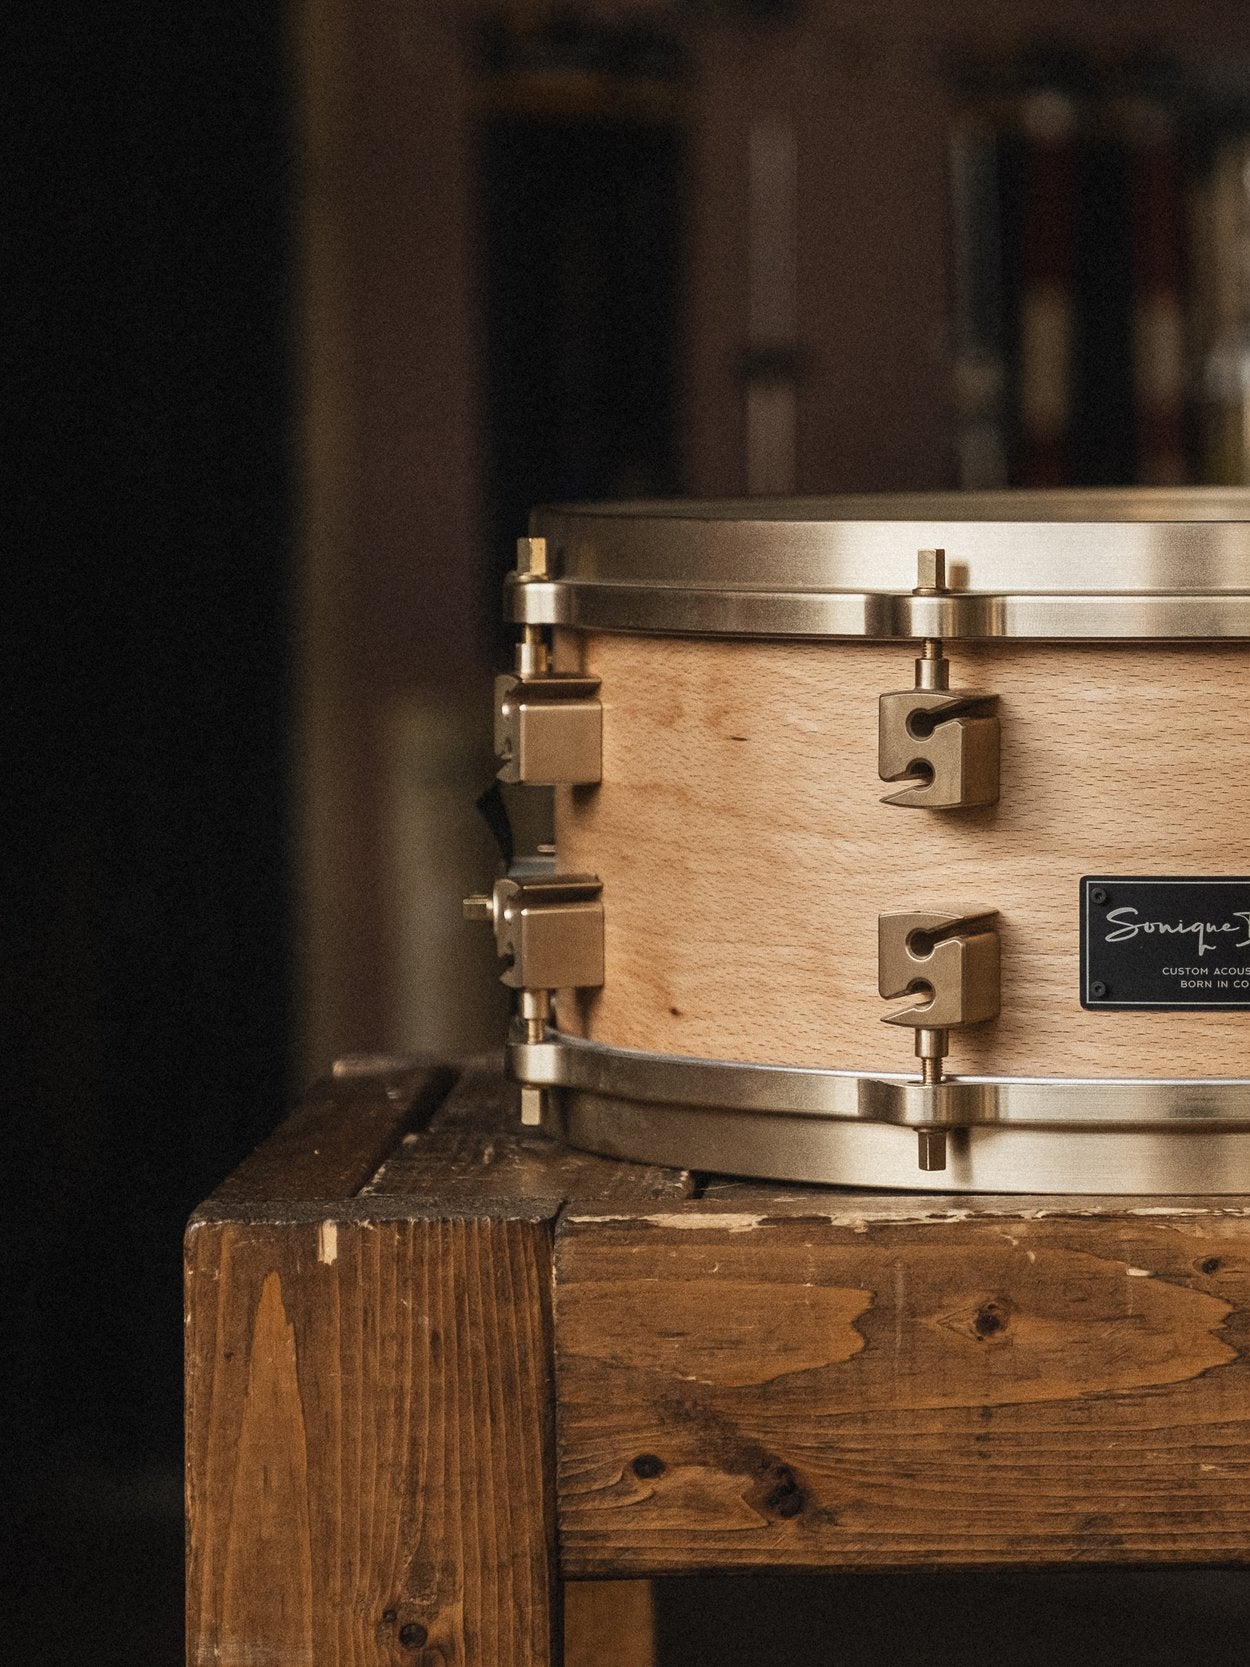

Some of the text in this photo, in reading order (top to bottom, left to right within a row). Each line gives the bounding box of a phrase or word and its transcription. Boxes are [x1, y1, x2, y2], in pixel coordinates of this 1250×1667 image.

[1105, 907, 1240, 956] Sonique
[1162, 966, 1209, 976] CUSTOM
[1180, 980, 1212, 989] BORN
[1217, 980, 1228, 988] IN
